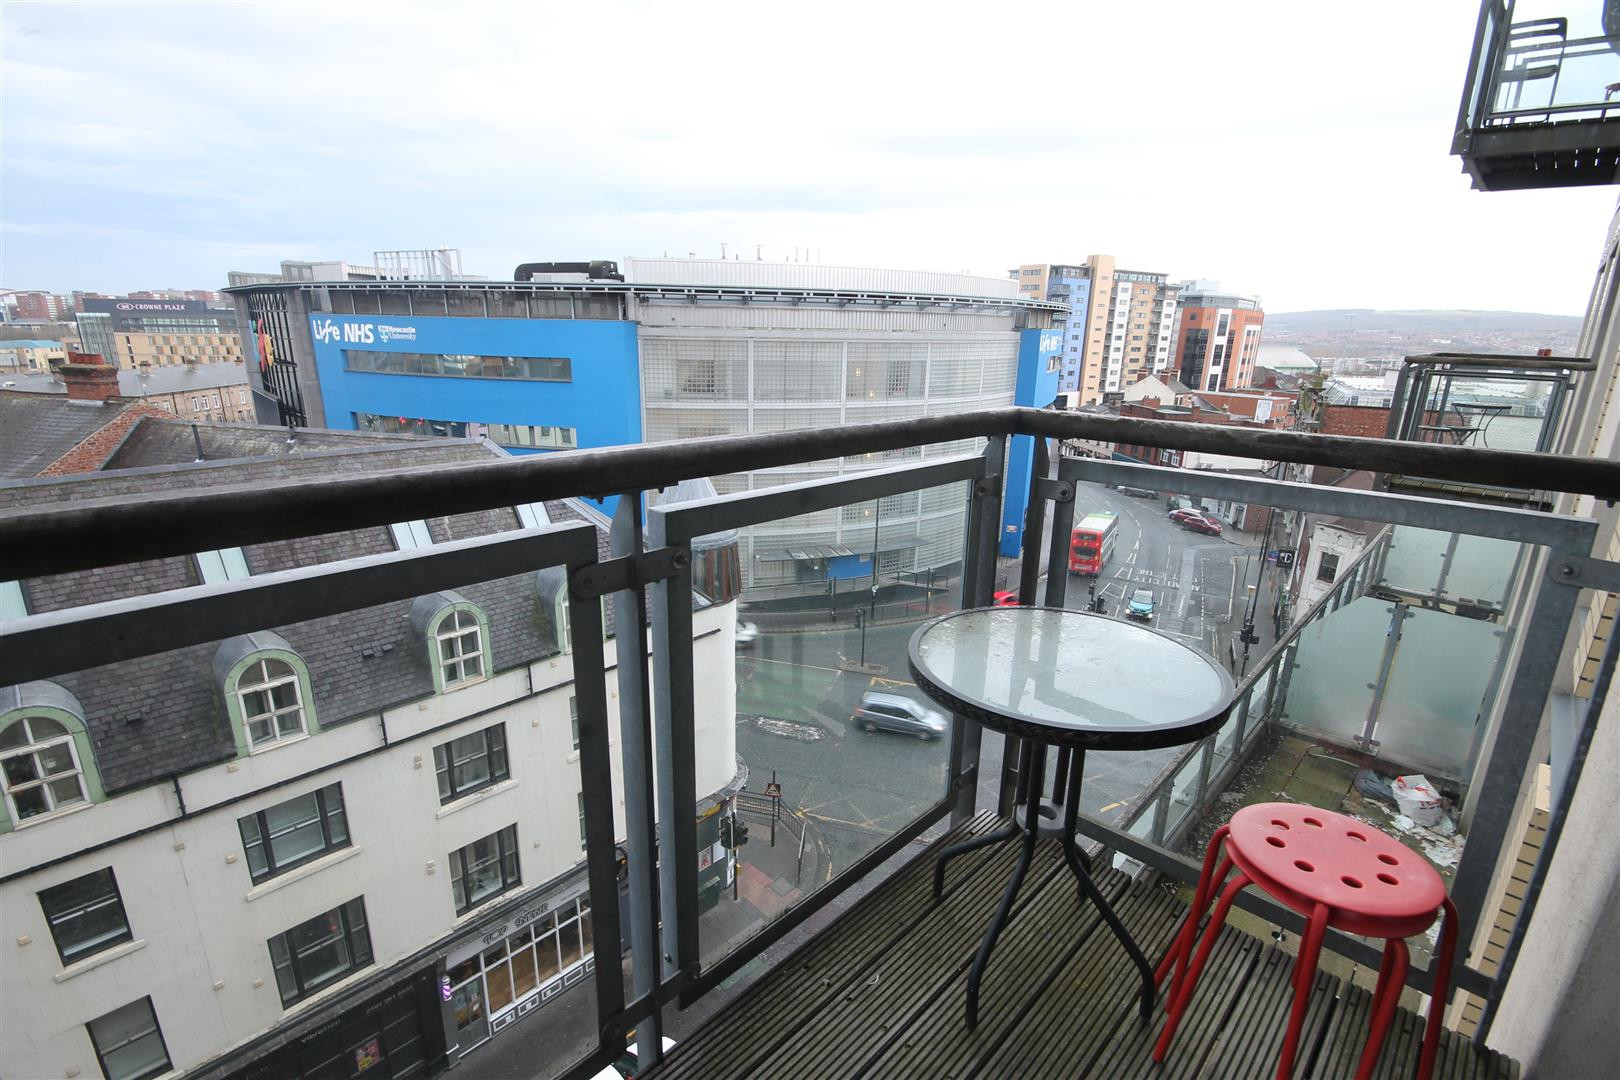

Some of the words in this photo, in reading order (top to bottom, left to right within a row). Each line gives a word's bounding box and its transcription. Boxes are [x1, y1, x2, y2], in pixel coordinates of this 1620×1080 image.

[135, 303, 162, 311] CROWNE
[312, 319, 341, 344] Life
[344, 322, 375, 344] NHS
[388, 325, 416, 334] Newcastle
[389, 332, 416, 342] University
